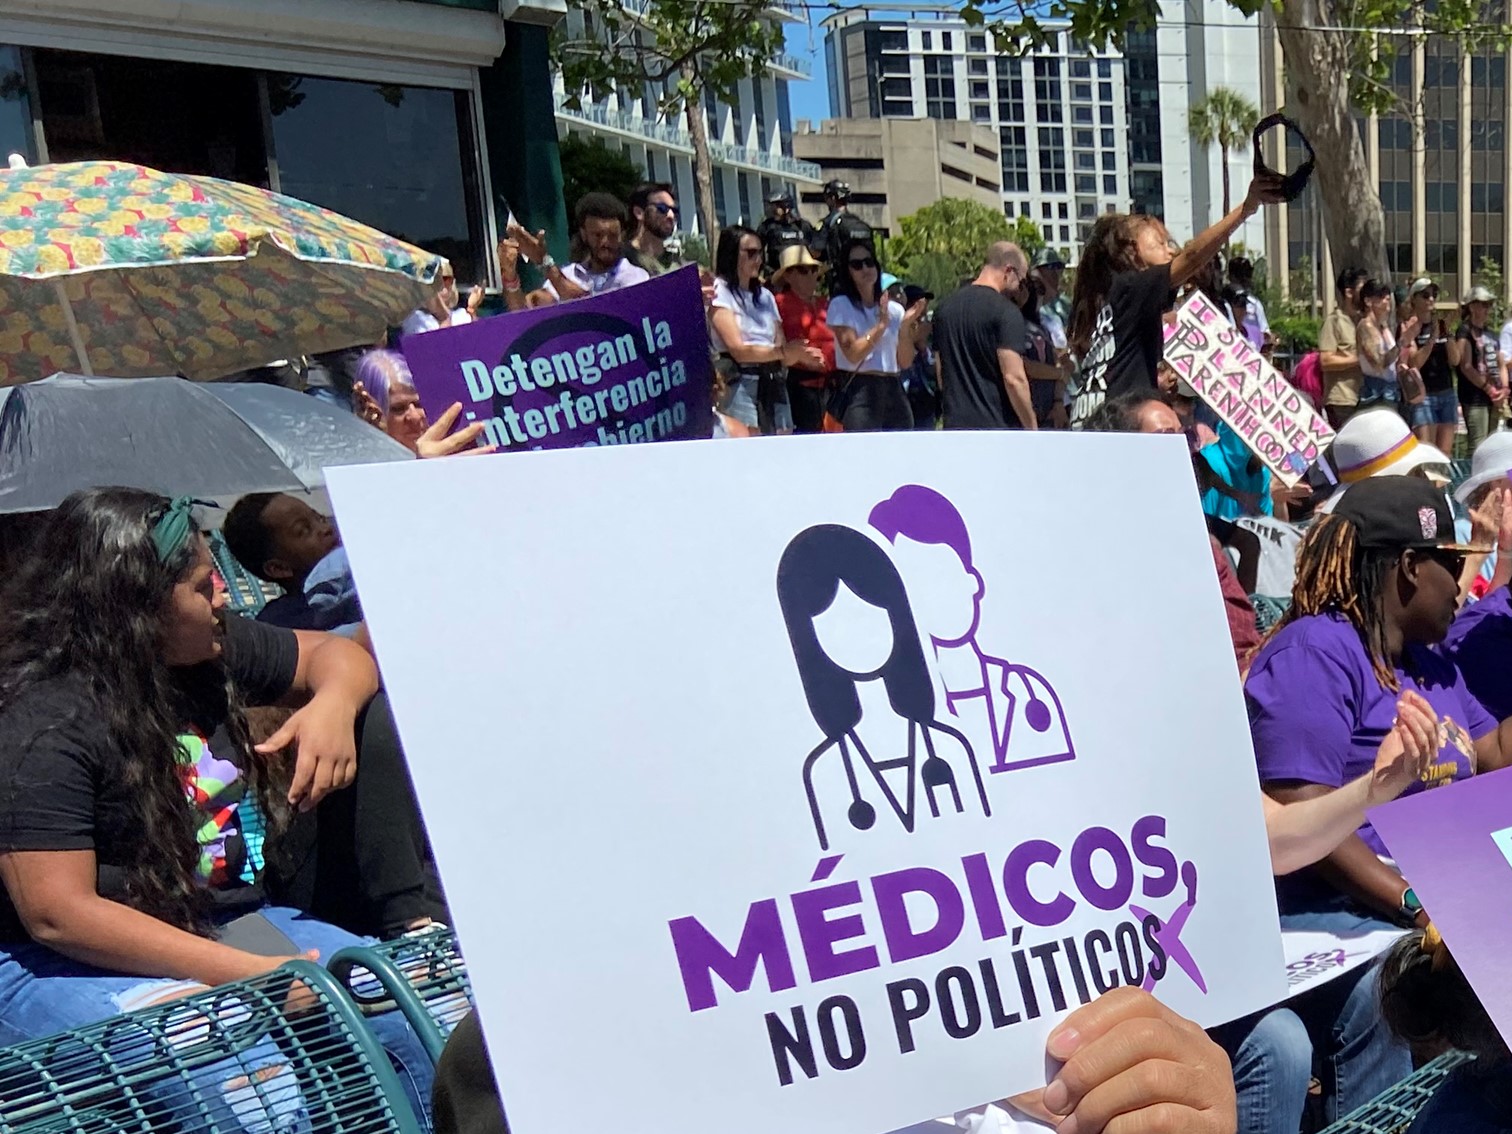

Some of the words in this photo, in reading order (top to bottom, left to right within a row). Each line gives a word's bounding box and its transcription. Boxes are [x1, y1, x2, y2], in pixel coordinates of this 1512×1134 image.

[460, 331, 638, 402] Detengan
[641, 316, 673, 354] la
[1164, 324, 1297, 475] PARENTHOOD
[1179, 319, 1319, 461] PLANNED
[1217, 326, 1302, 413] STAND
[668, 815, 1197, 1012] MÉDICOS,
[765, 994, 867, 1087] NO
[886, 914, 1167, 1054] POLÍTICOS
